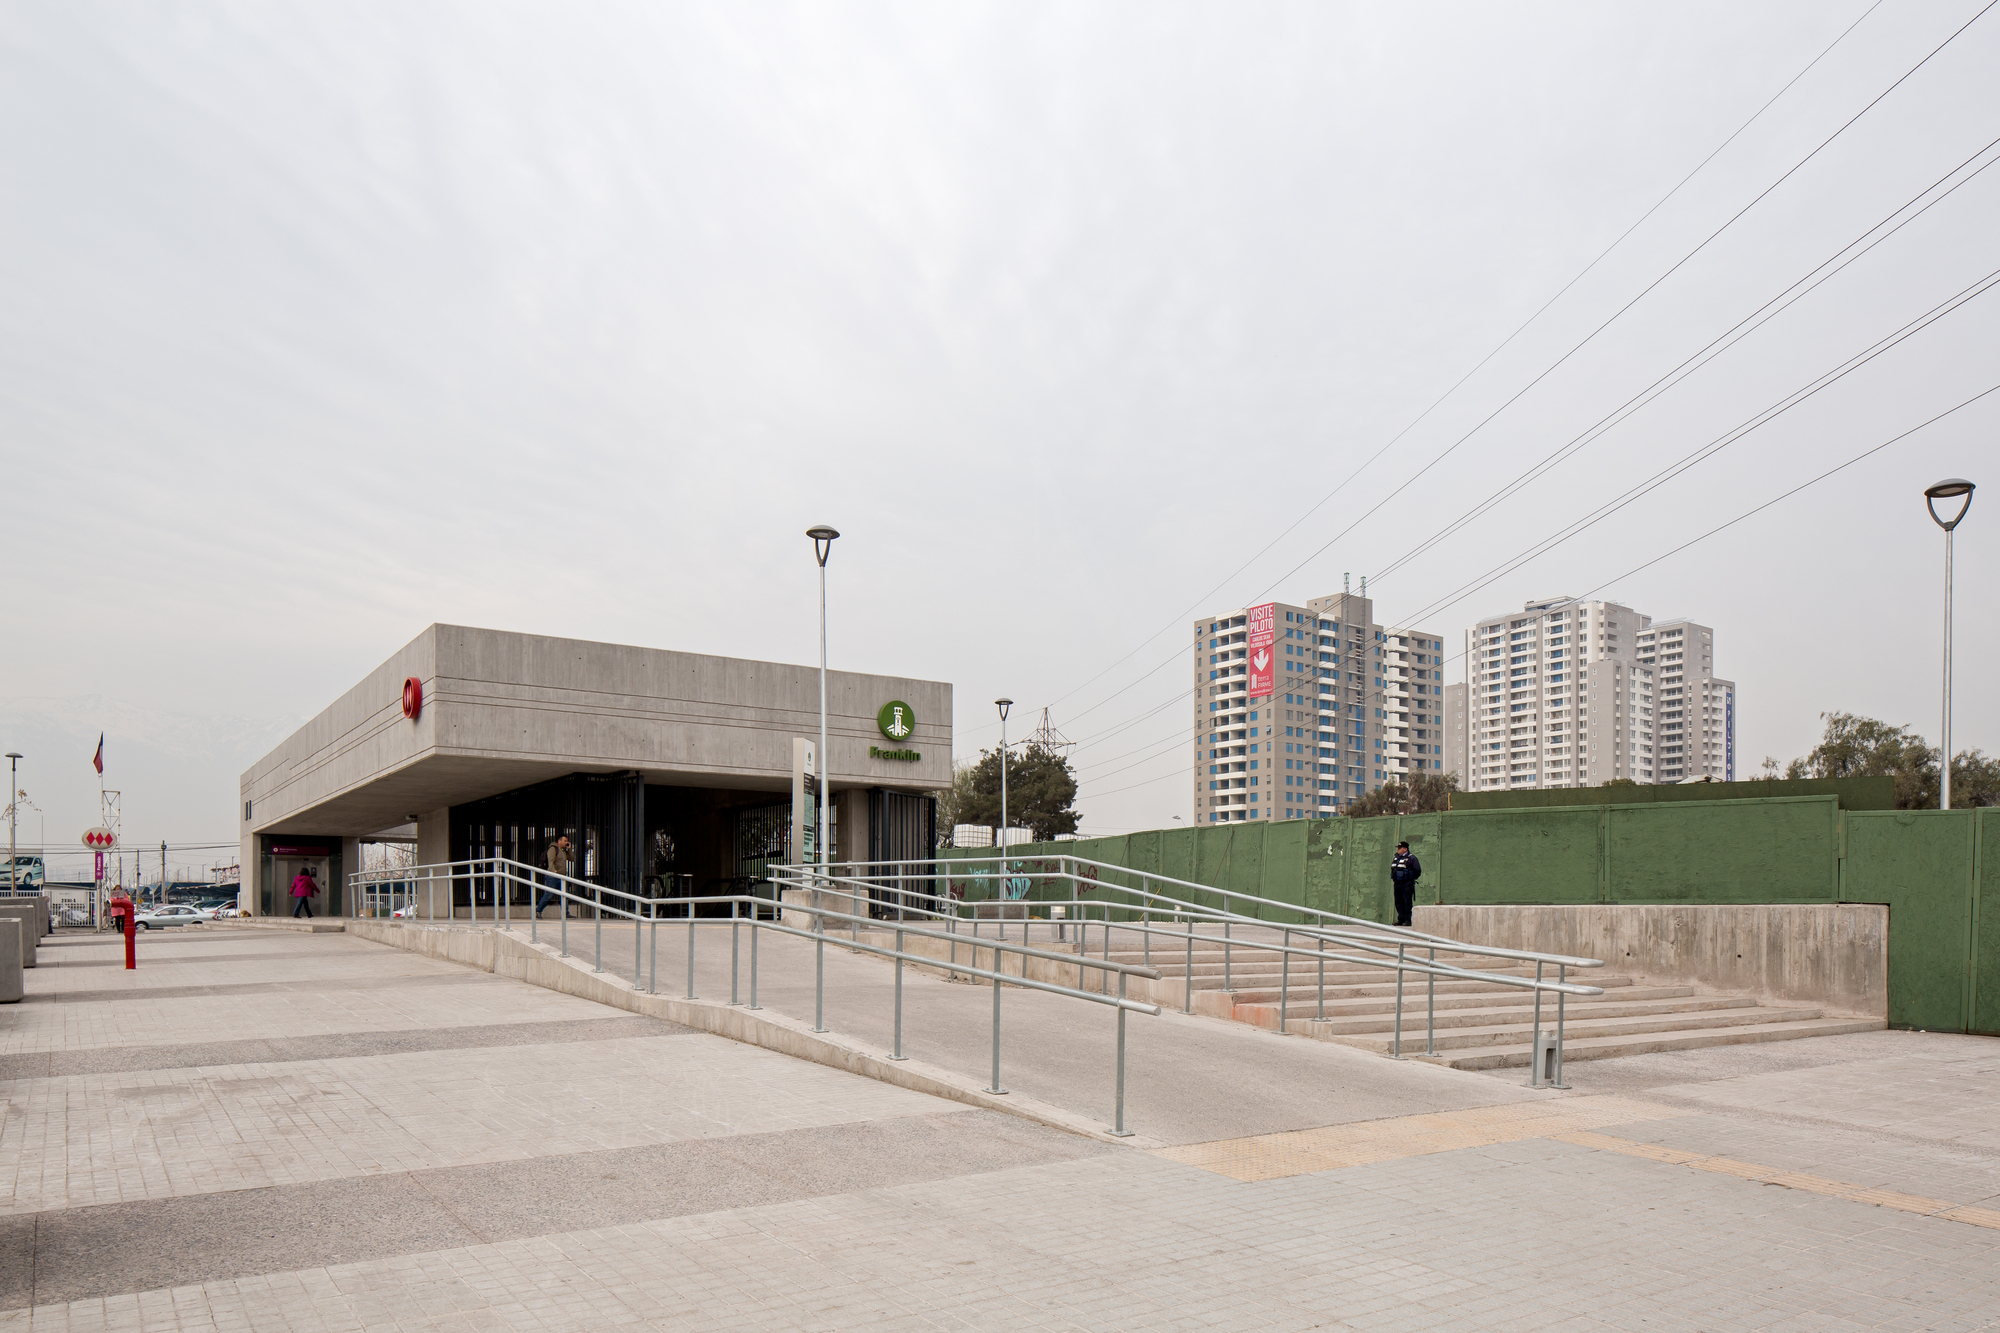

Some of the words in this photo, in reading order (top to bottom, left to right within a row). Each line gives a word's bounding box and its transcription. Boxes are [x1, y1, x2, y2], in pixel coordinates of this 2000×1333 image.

[1250, 604, 1273, 621] VISITE
[1250, 617, 1273, 633] PILOTO
[870, 746, 921, 761] Franklin
